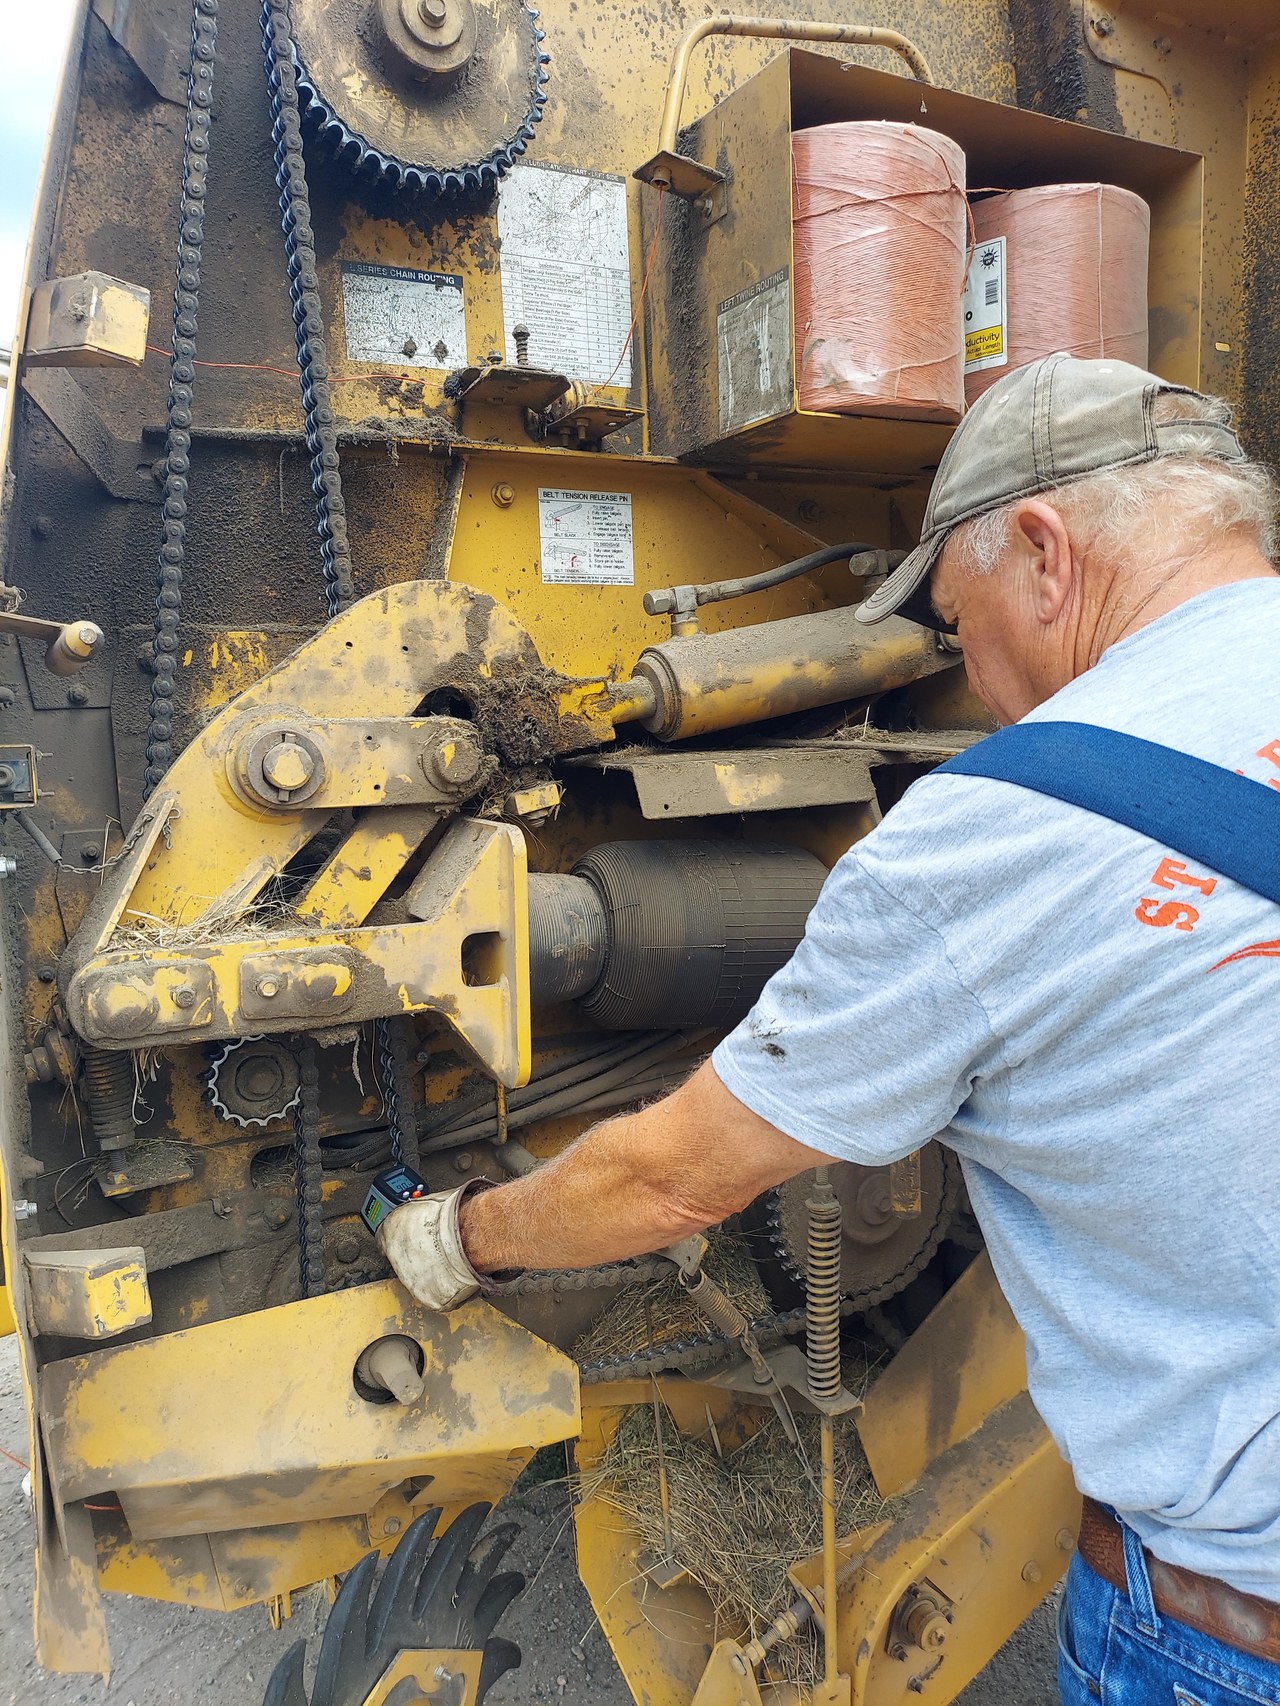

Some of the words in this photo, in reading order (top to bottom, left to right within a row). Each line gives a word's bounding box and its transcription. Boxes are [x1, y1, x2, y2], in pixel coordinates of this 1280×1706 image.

[357, 264, 388, 276] SERIES
[390, 269, 416, 280] CHAIN
[417, 272, 455, 285] ROUNG
[721, 296, 736, 311] LEFT
[755, 270, 784, 294] ROUTING
[542, 491, 559, 499] BELT
[561, 492, 588, 500] TENSION
[589, 493, 617, 502] RELEASE
